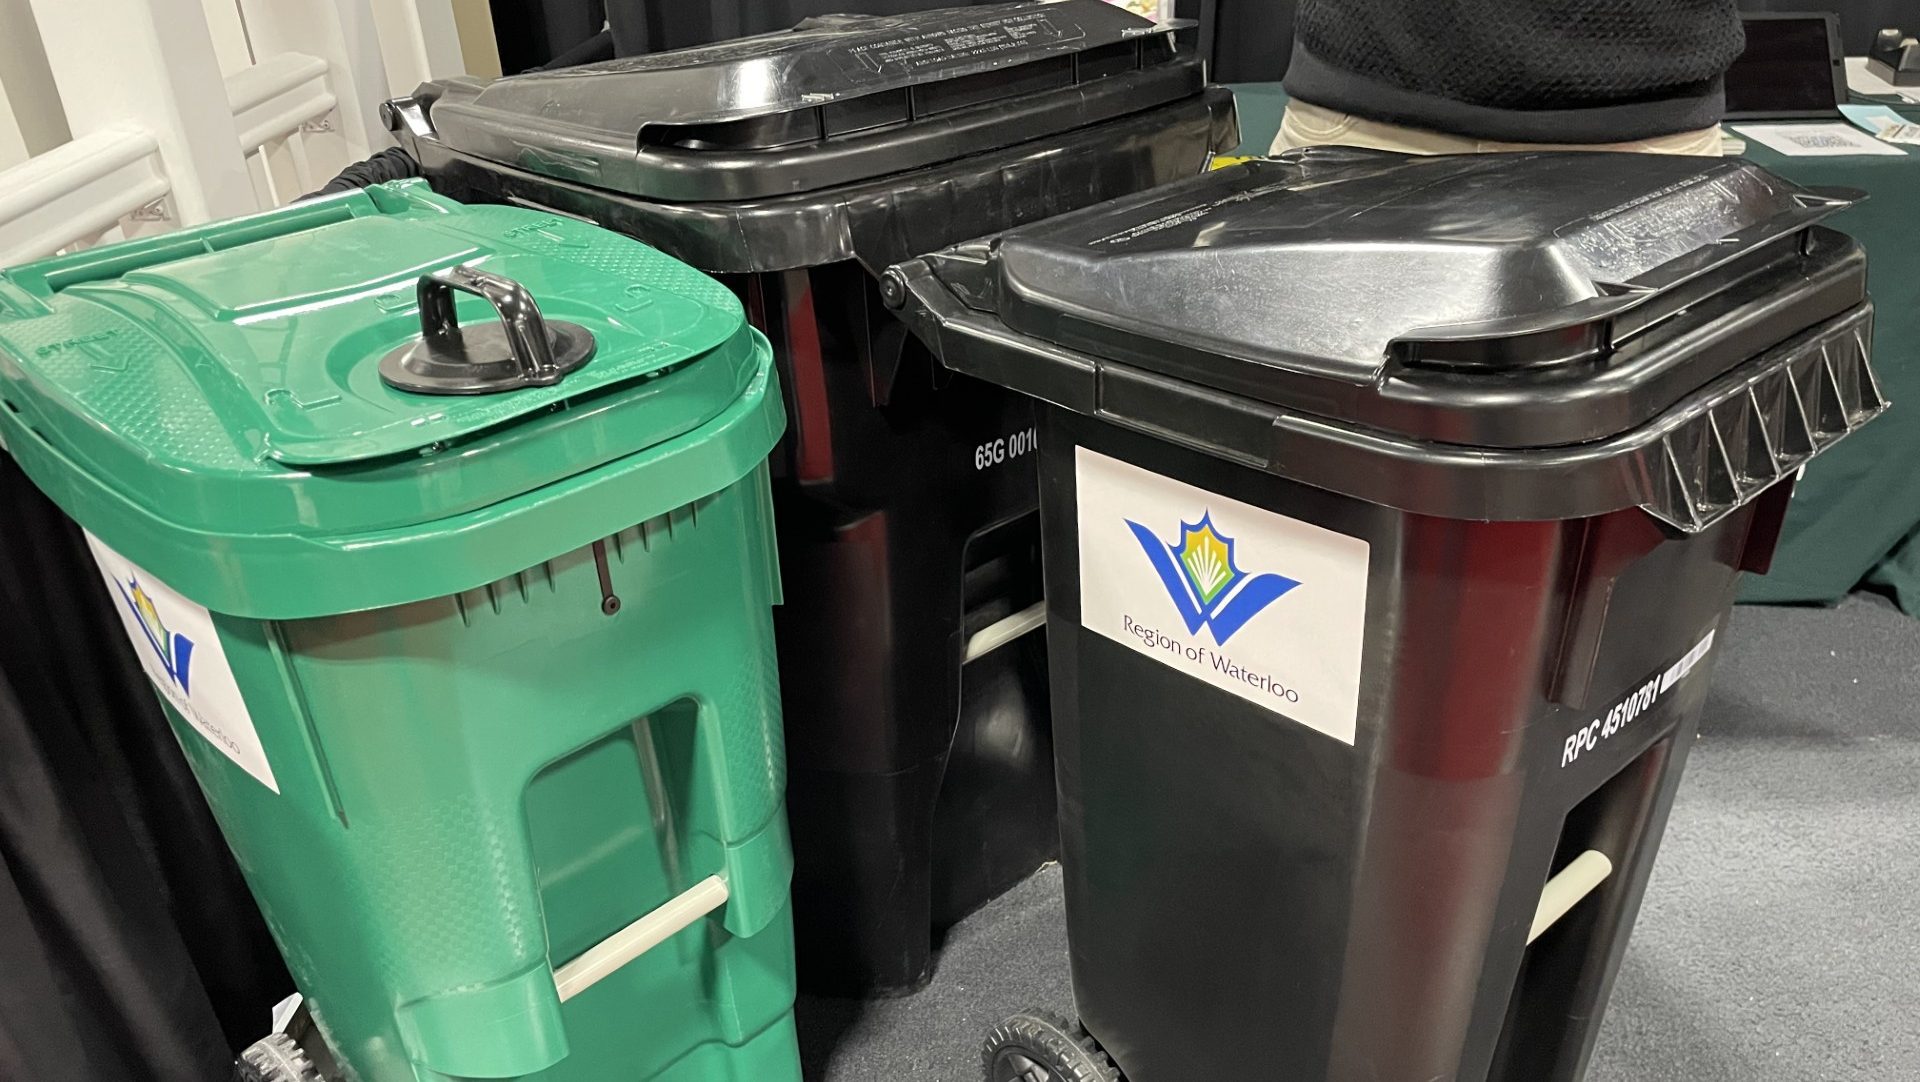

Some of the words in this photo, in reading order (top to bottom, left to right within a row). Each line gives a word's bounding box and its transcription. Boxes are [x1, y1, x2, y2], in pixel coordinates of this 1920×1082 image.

[975, 437, 1005, 471] 65G
[1123, 614, 1181, 654] Region
[1185, 647, 1207, 664] of
[1210, 652, 1298, 703] Waterloo
[1561, 719, 1600, 767] RPC
[1602, 674, 1661, 739] 4510781
